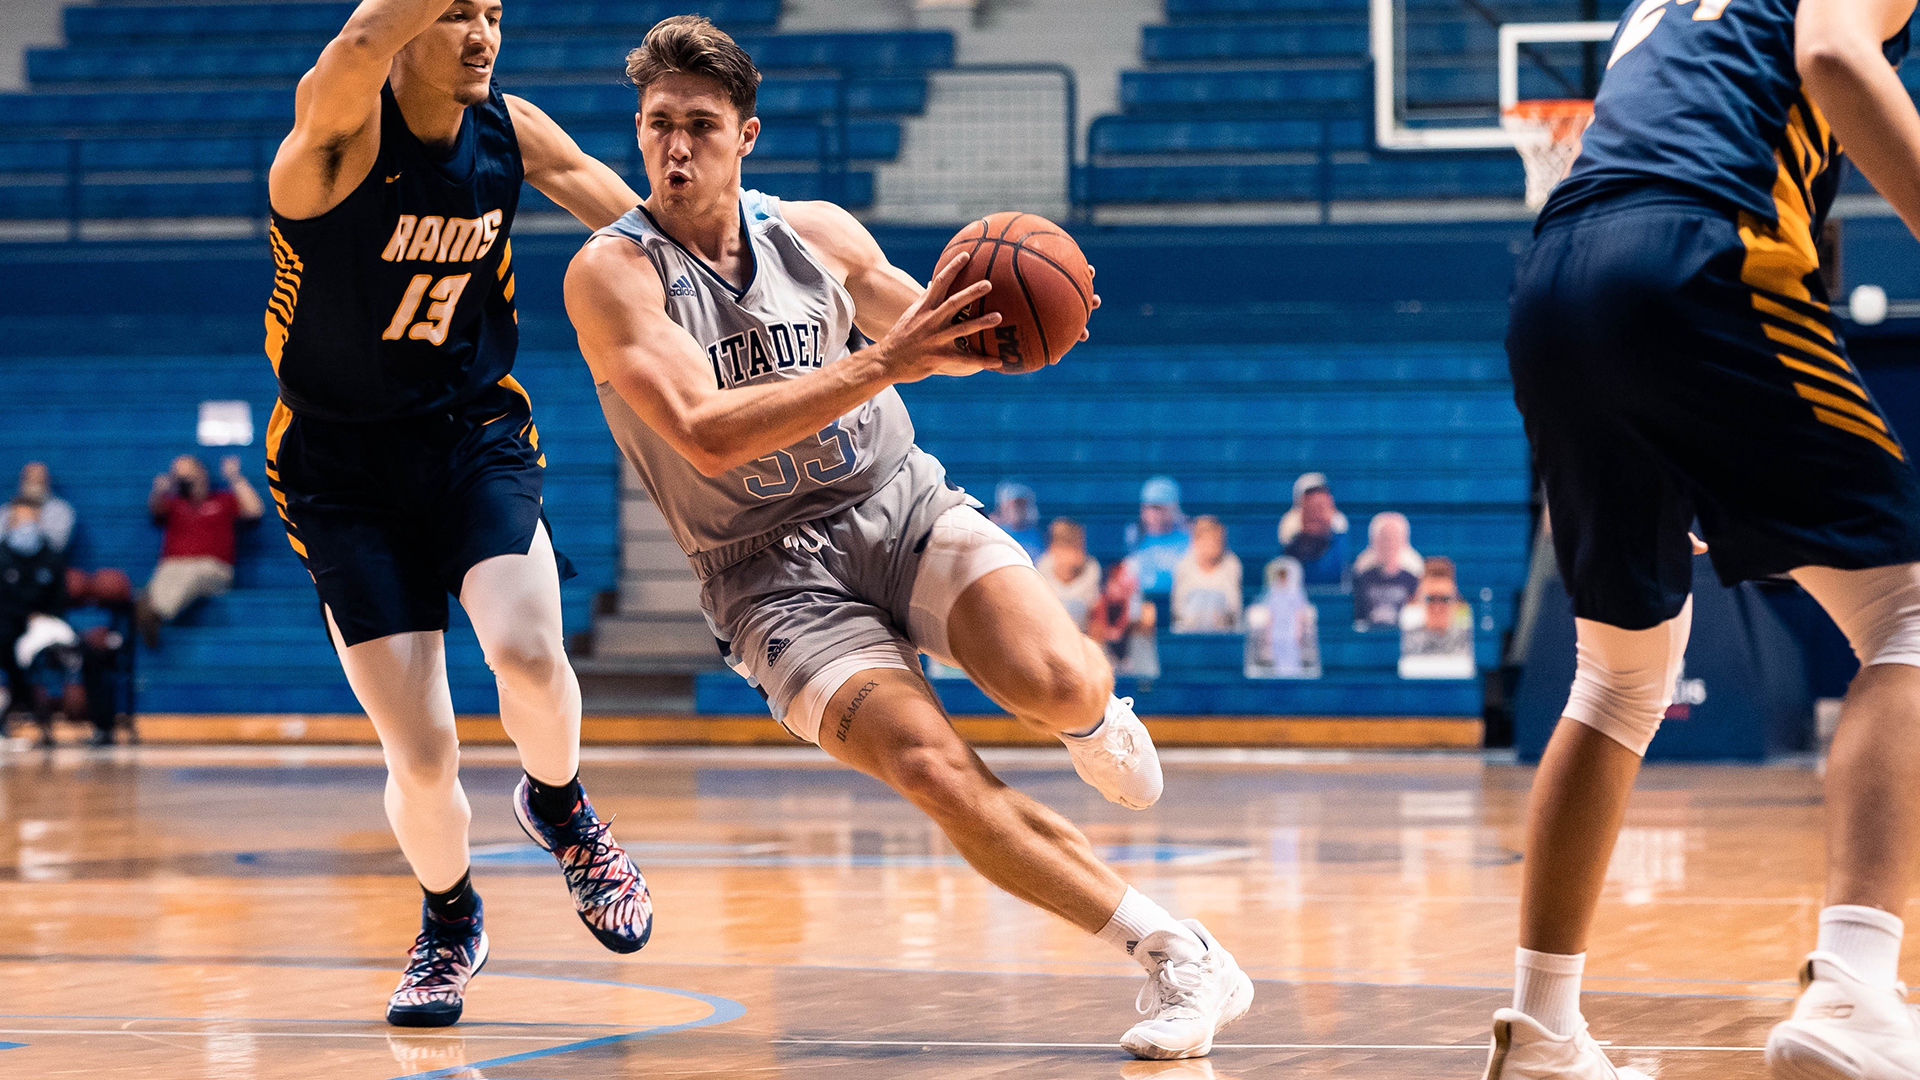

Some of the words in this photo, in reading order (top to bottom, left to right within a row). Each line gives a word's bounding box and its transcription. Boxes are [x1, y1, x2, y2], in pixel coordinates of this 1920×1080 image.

[381, 208, 503, 263] RAMS
[382, 272, 472, 346] 13
[706, 321, 825, 391] ITADEL
[994, 324, 1024, 371] CAA
[767, 637, 791, 668] adidas
